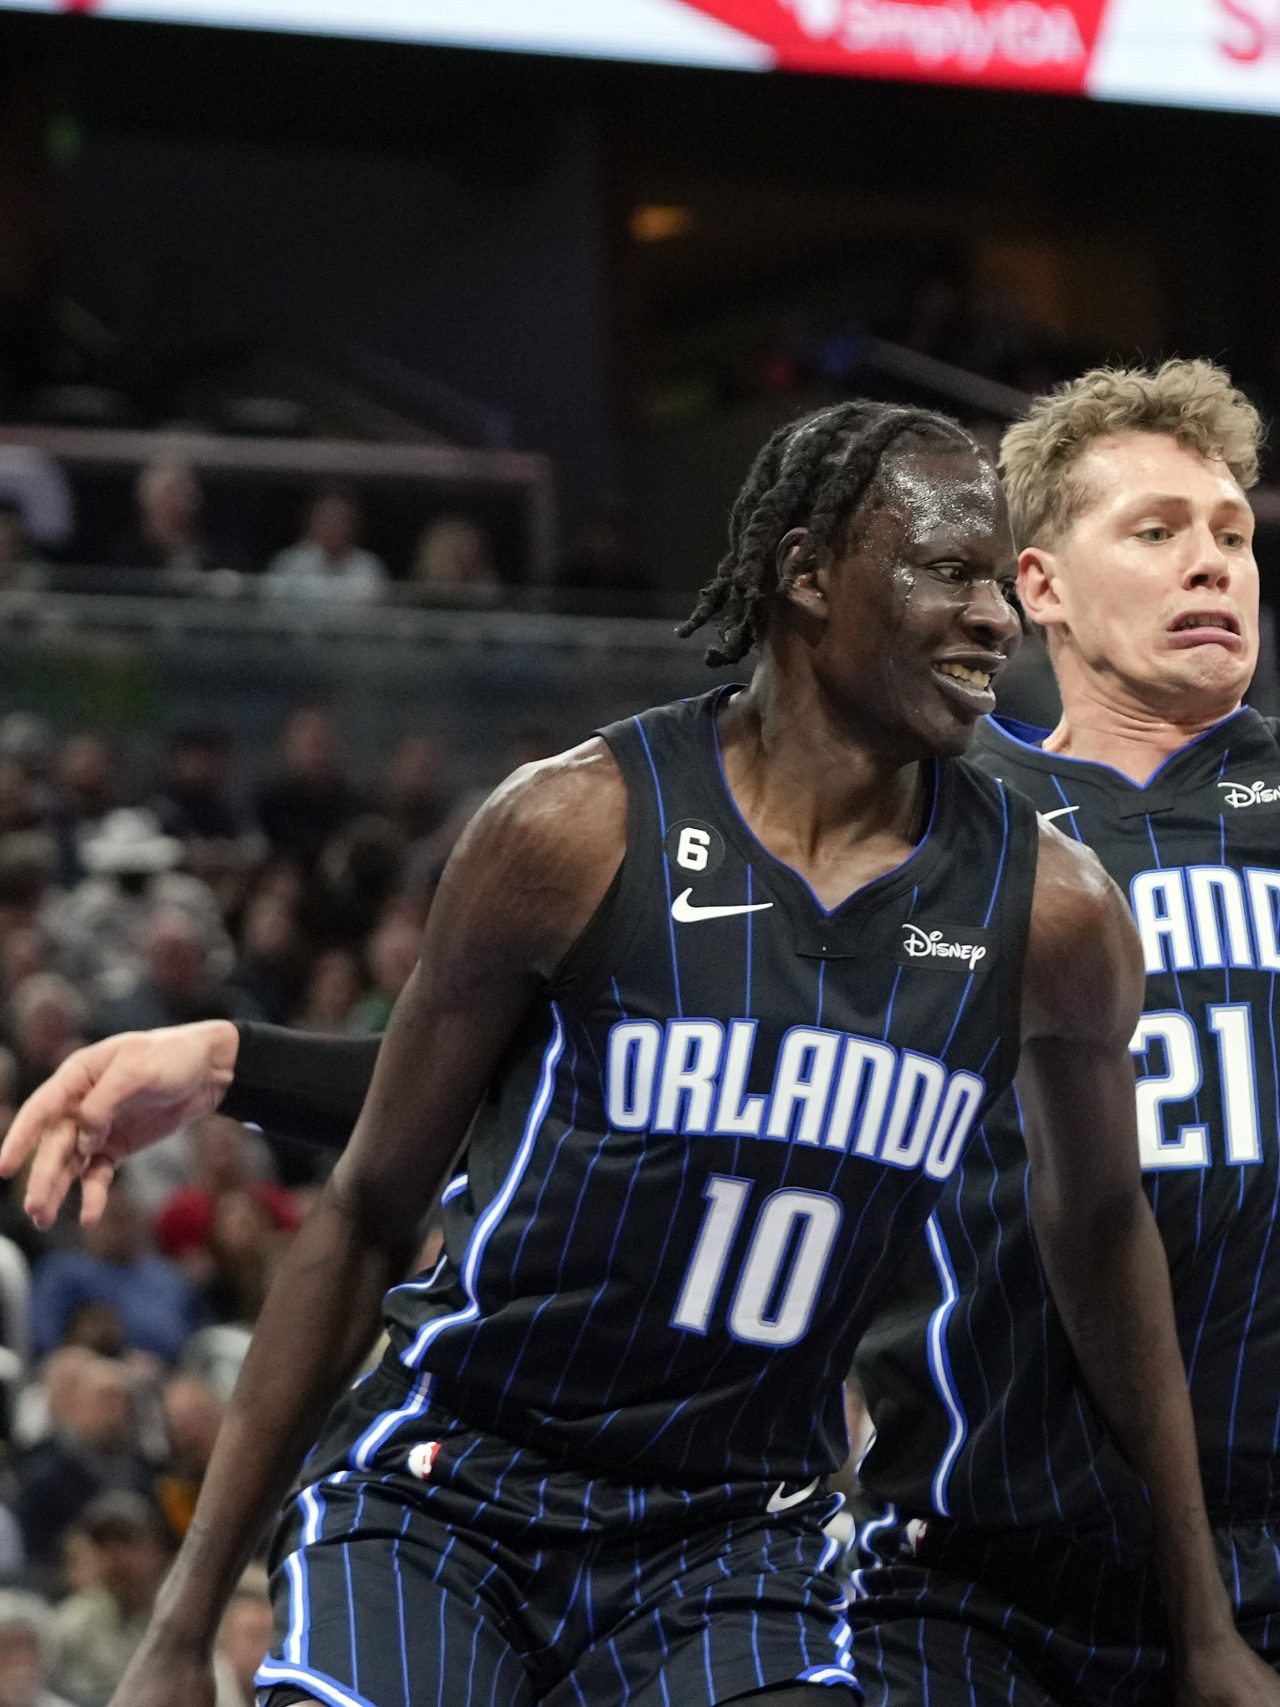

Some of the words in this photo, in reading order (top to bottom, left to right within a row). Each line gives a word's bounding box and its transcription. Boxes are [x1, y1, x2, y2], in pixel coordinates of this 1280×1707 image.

[677, 827, 710, 871] 6
[902, 923, 986, 970] Disney
[607, 1017, 985, 1182] ORLANDO
[1128, 1002, 1263, 1172] 21
[669, 1172, 845, 1348] 10
